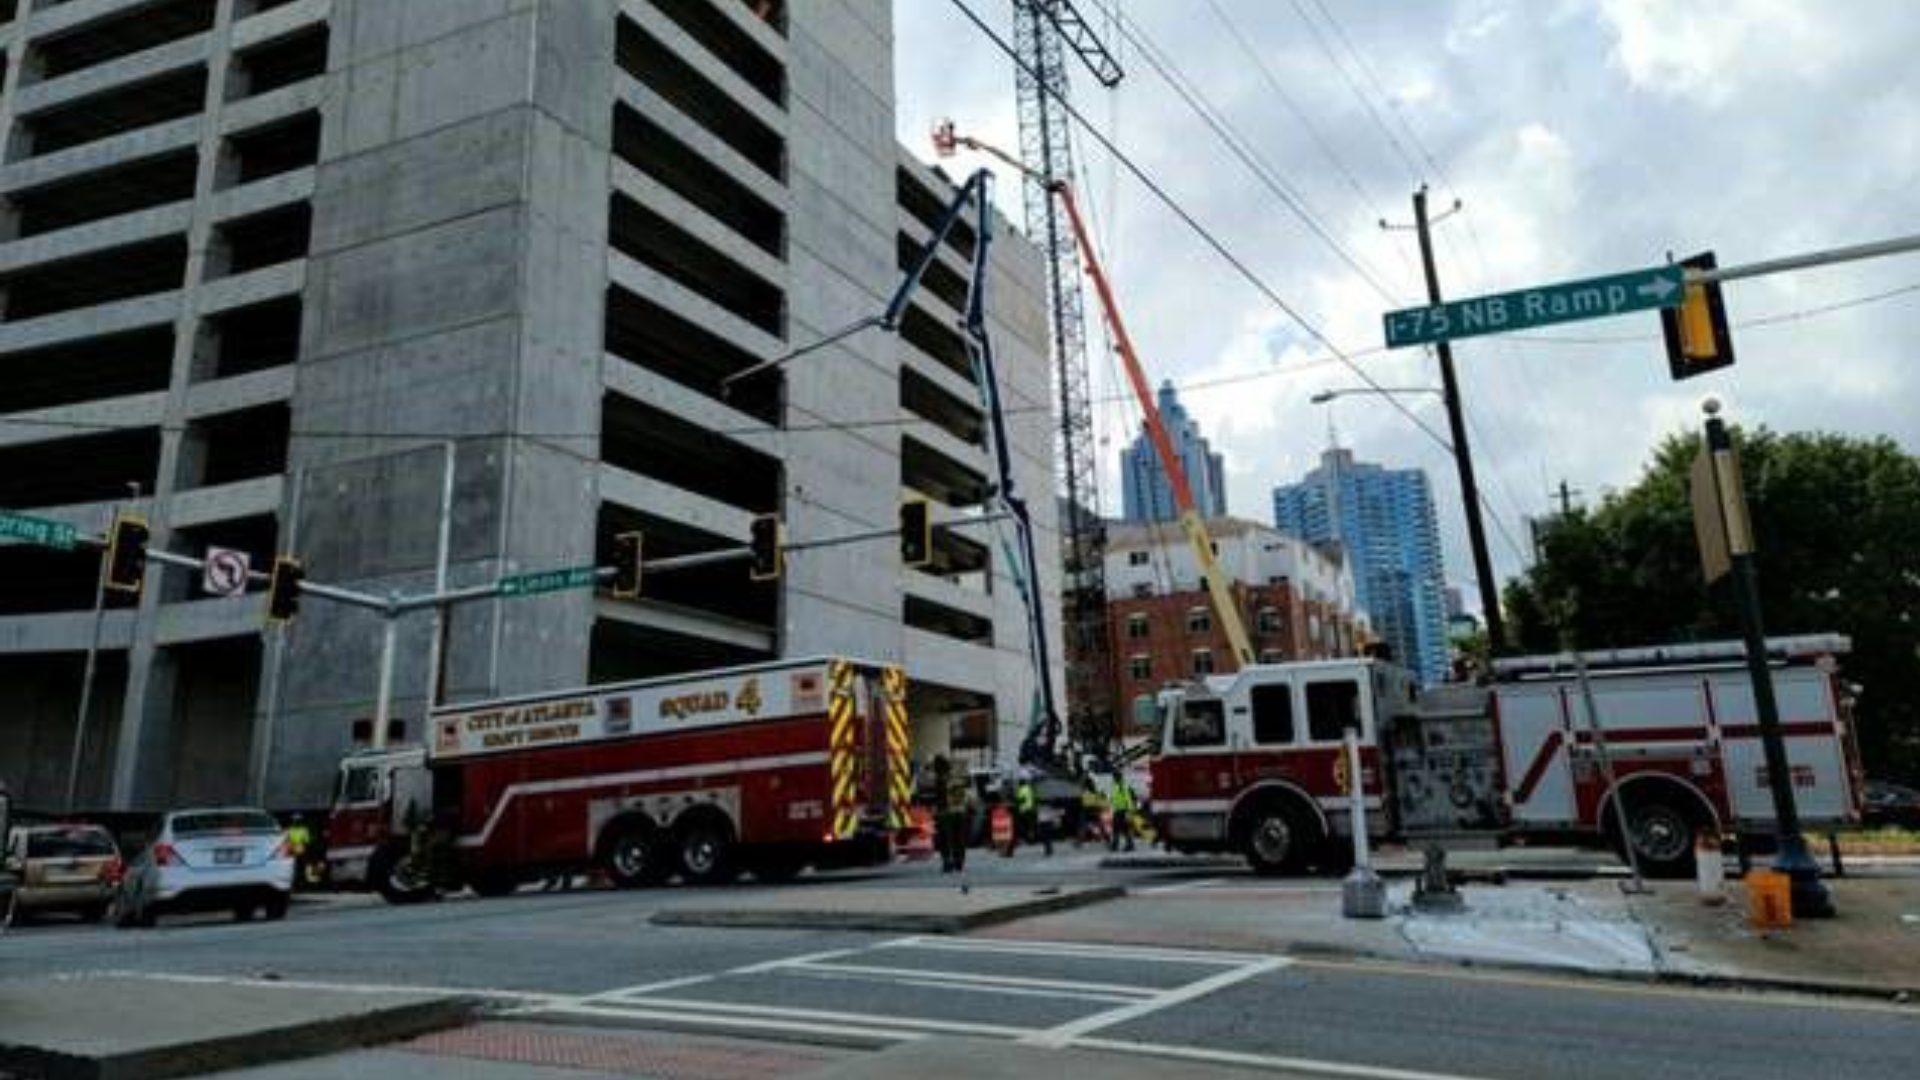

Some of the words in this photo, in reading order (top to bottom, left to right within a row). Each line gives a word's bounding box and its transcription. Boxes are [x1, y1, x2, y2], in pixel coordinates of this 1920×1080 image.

[1388, 307, 1451, 341] I-75
[1462, 299, 1509, 331] NB
[1523, 284, 1626, 318] Ramp
[467, 712, 503, 731] CITY
[521, 700, 595, 722] ATLANTA
[658, 691, 729, 719] SQUAD
[735, 678, 762, 714] 4
